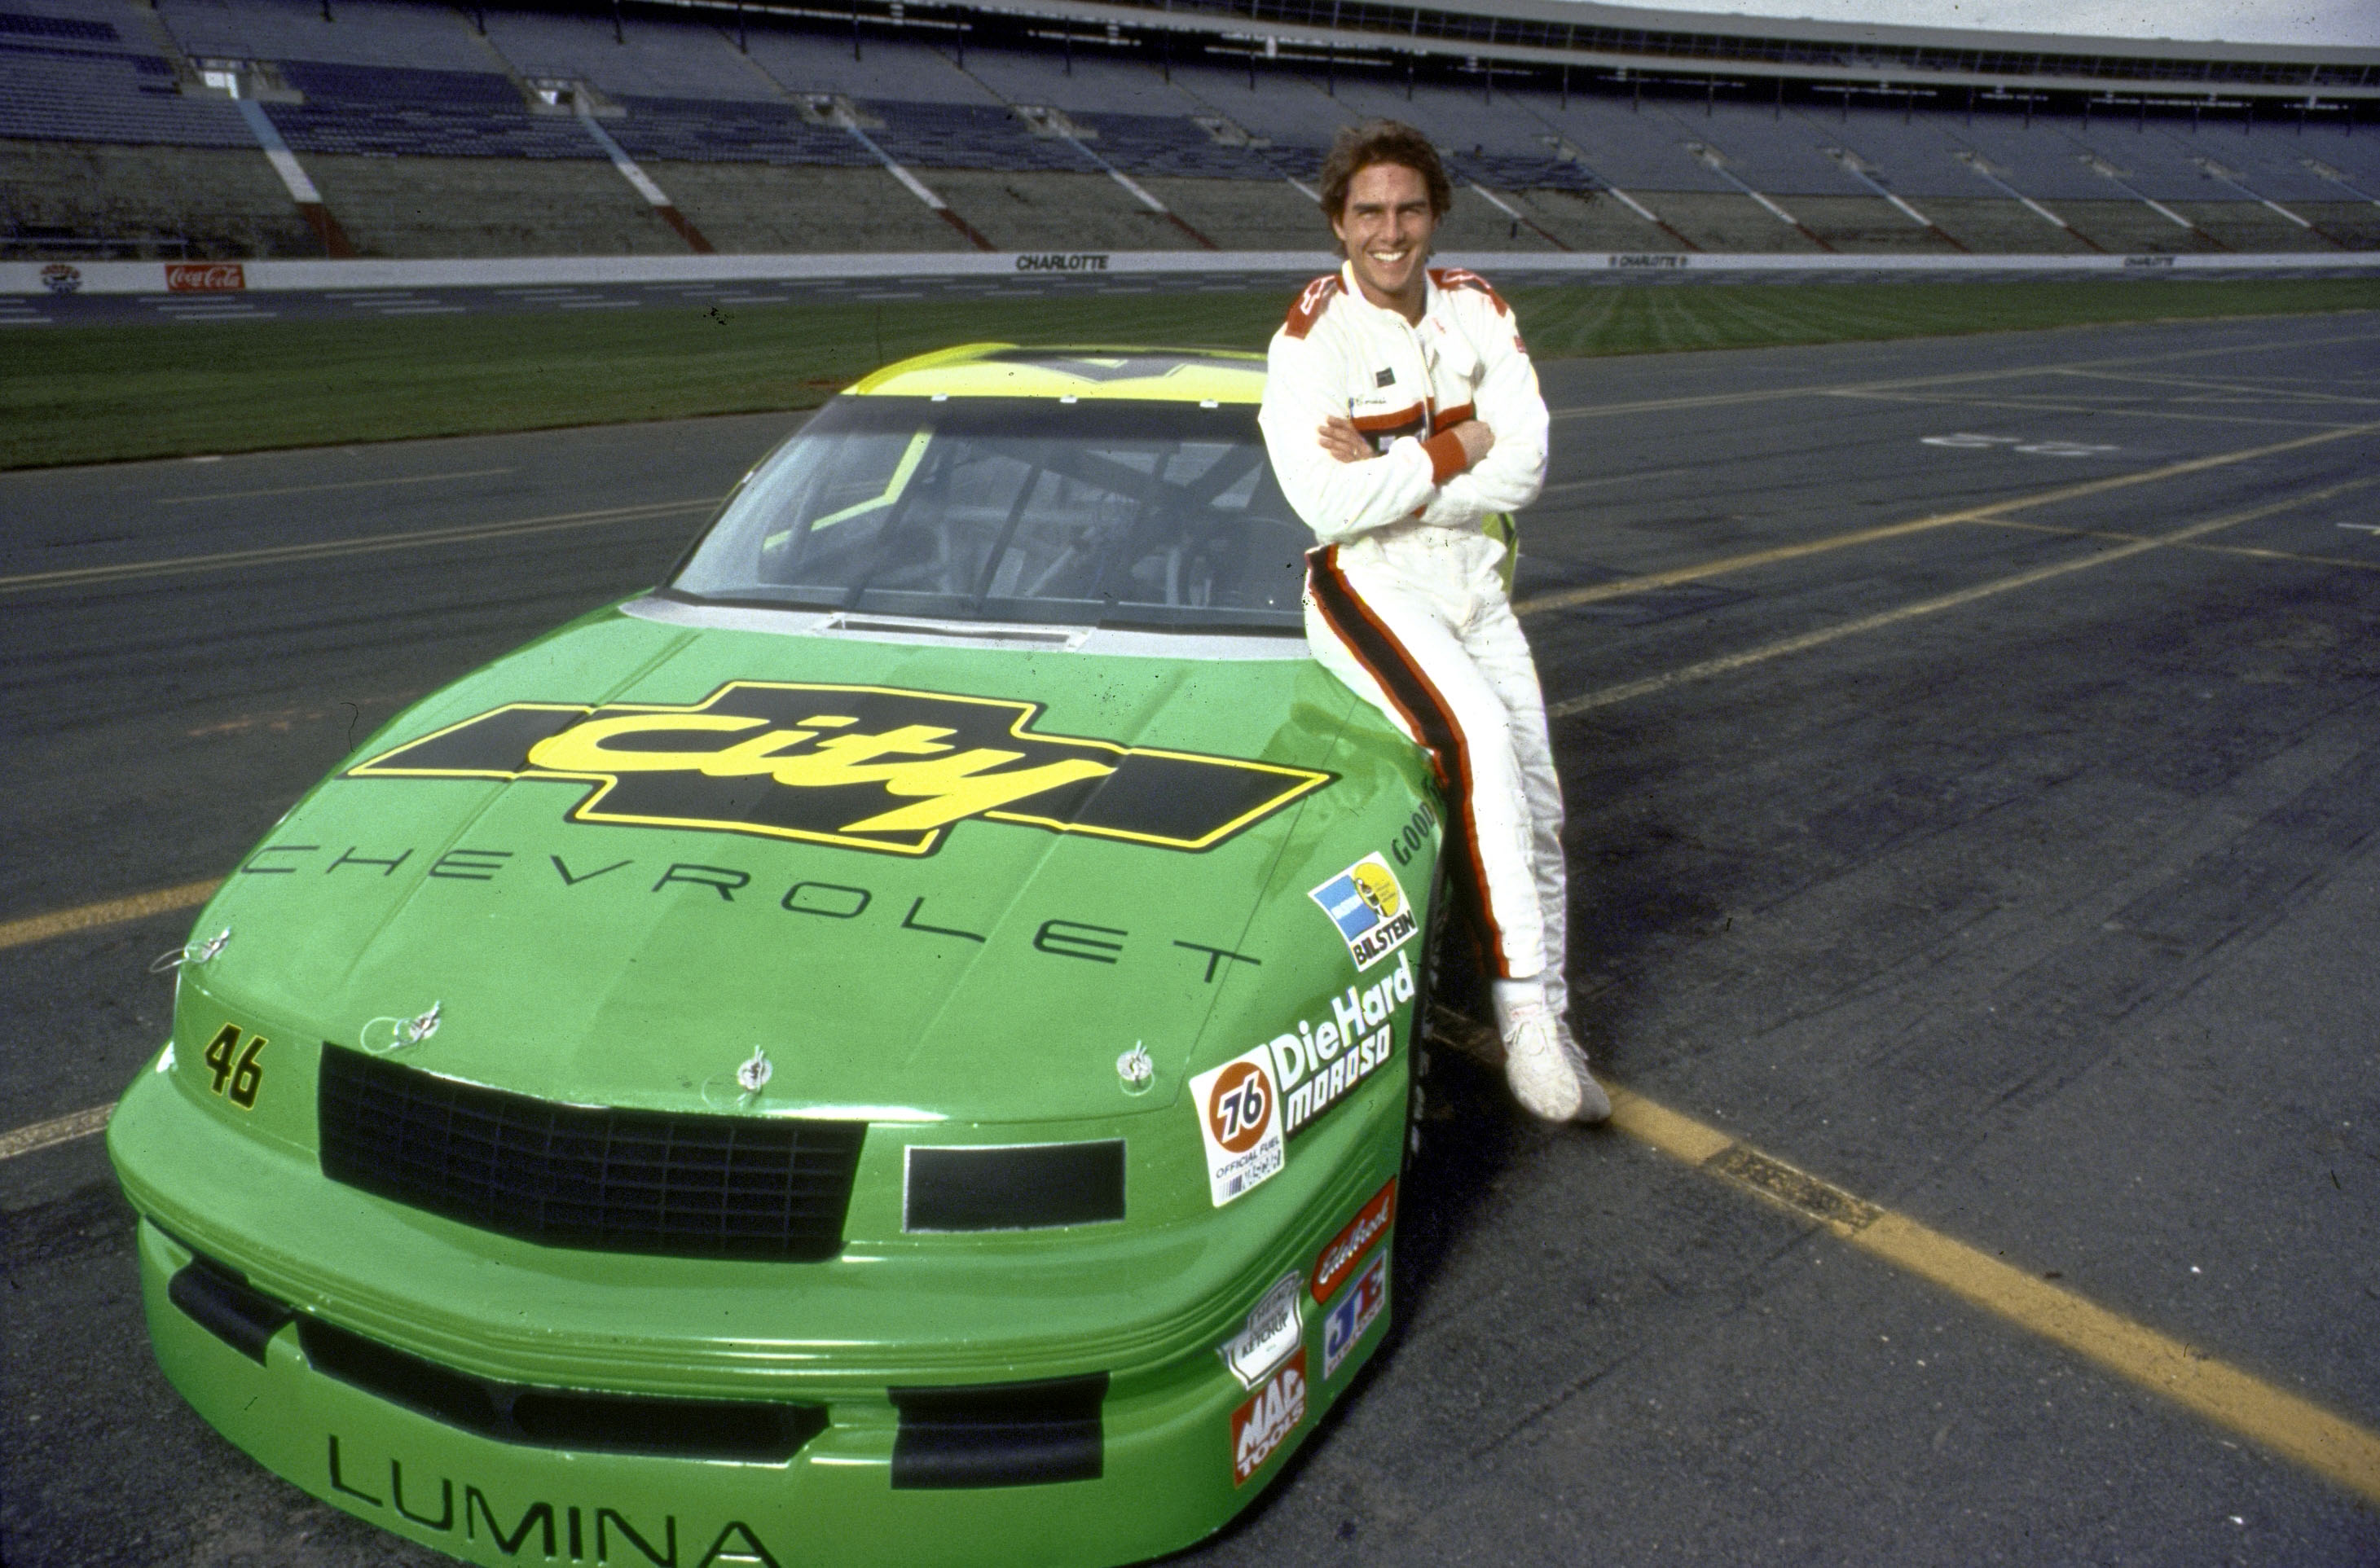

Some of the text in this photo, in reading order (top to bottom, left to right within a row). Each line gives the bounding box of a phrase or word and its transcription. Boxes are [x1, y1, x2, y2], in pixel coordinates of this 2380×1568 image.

[1016, 254, 1109, 270] CHARLOTTE
[527, 714, 1119, 832] City
[240, 845, 1262, 983] CHEVROLET
[1353, 909, 1417, 966] BILSTEIN
[204, 1021, 270, 1112] 46
[1269, 949, 1414, 1093] DieHard
[1216, 1069, 1267, 1144] 76
[1286, 1023, 1391, 1134] MOROSO
[1216, 1149, 1258, 1179] OFFICIAL
[1237, 1368, 1305, 1464] MAC
[1238, 1399, 1304, 1478] TOOLS
[328, 1434, 783, 1568] LUMINA
